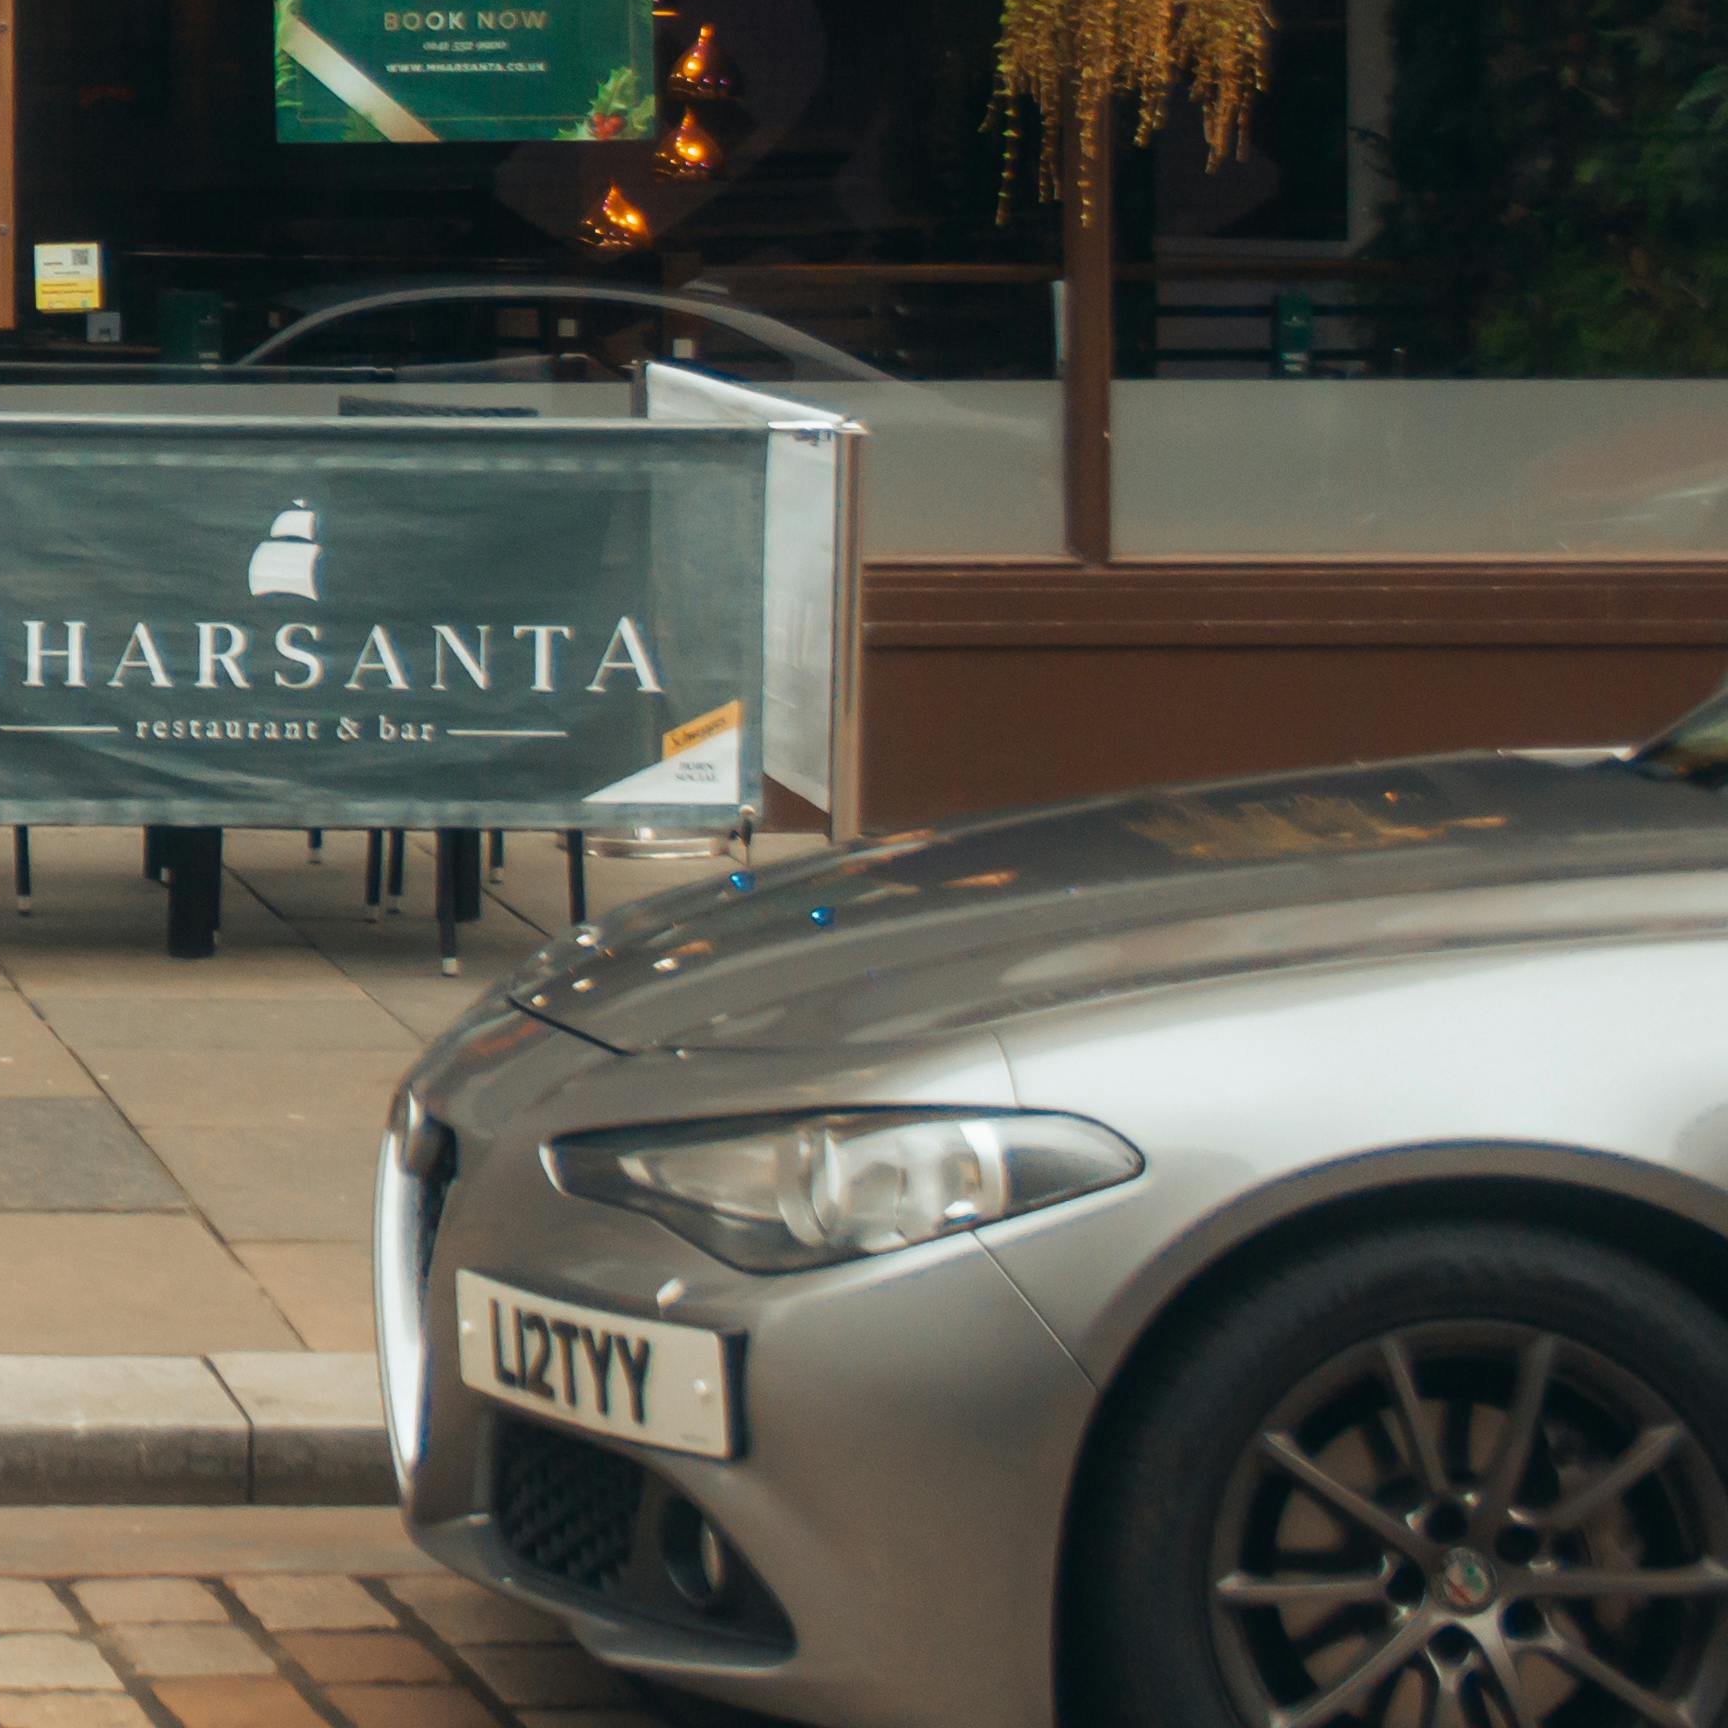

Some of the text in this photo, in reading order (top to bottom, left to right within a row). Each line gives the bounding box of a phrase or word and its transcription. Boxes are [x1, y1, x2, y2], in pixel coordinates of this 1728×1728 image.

[384, 11, 545, 31] BOOK NOW
[135, 714, 435, 742] restaurant & bar
